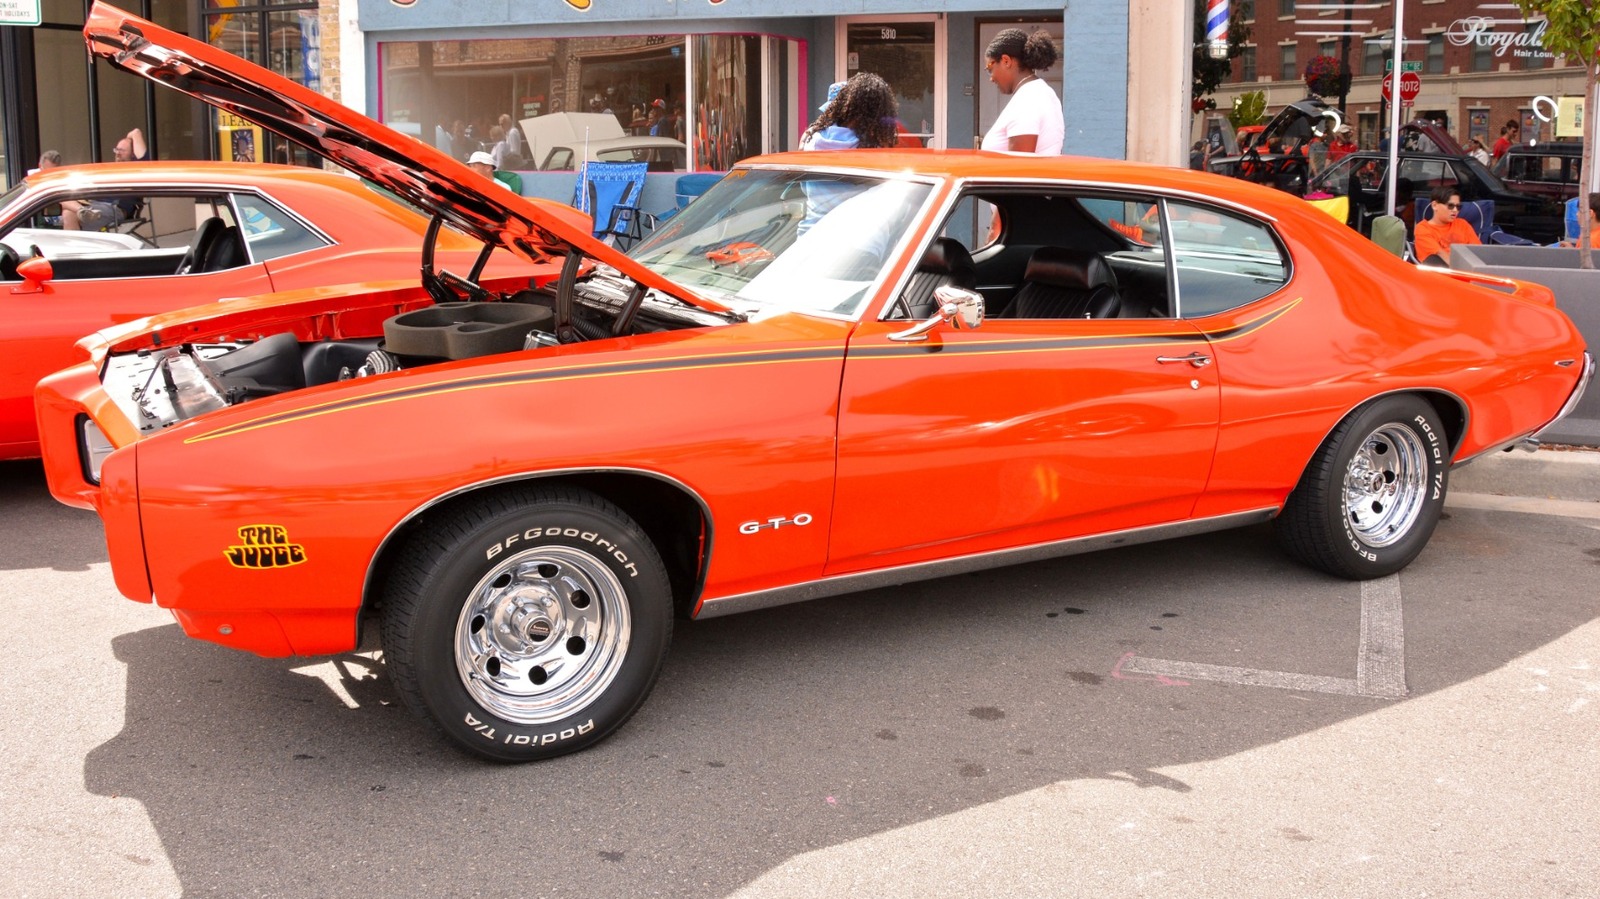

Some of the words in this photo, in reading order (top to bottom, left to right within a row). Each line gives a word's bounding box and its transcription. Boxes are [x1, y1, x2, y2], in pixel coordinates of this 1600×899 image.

[881, 28, 896, 39] 5810
[1513, 49, 1532, 57] Hair
[1414, 415, 1443, 465] Radial
[1432, 471, 1443, 500] T/A
[238, 524, 287, 546] THE
[739, 513, 812, 534] GTO
[223, 544, 308, 569] JUDGE
[486, 527, 639, 578] BFGoodrich
[464, 712, 496, 740] T/A
[504, 718, 595, 747] Radial
